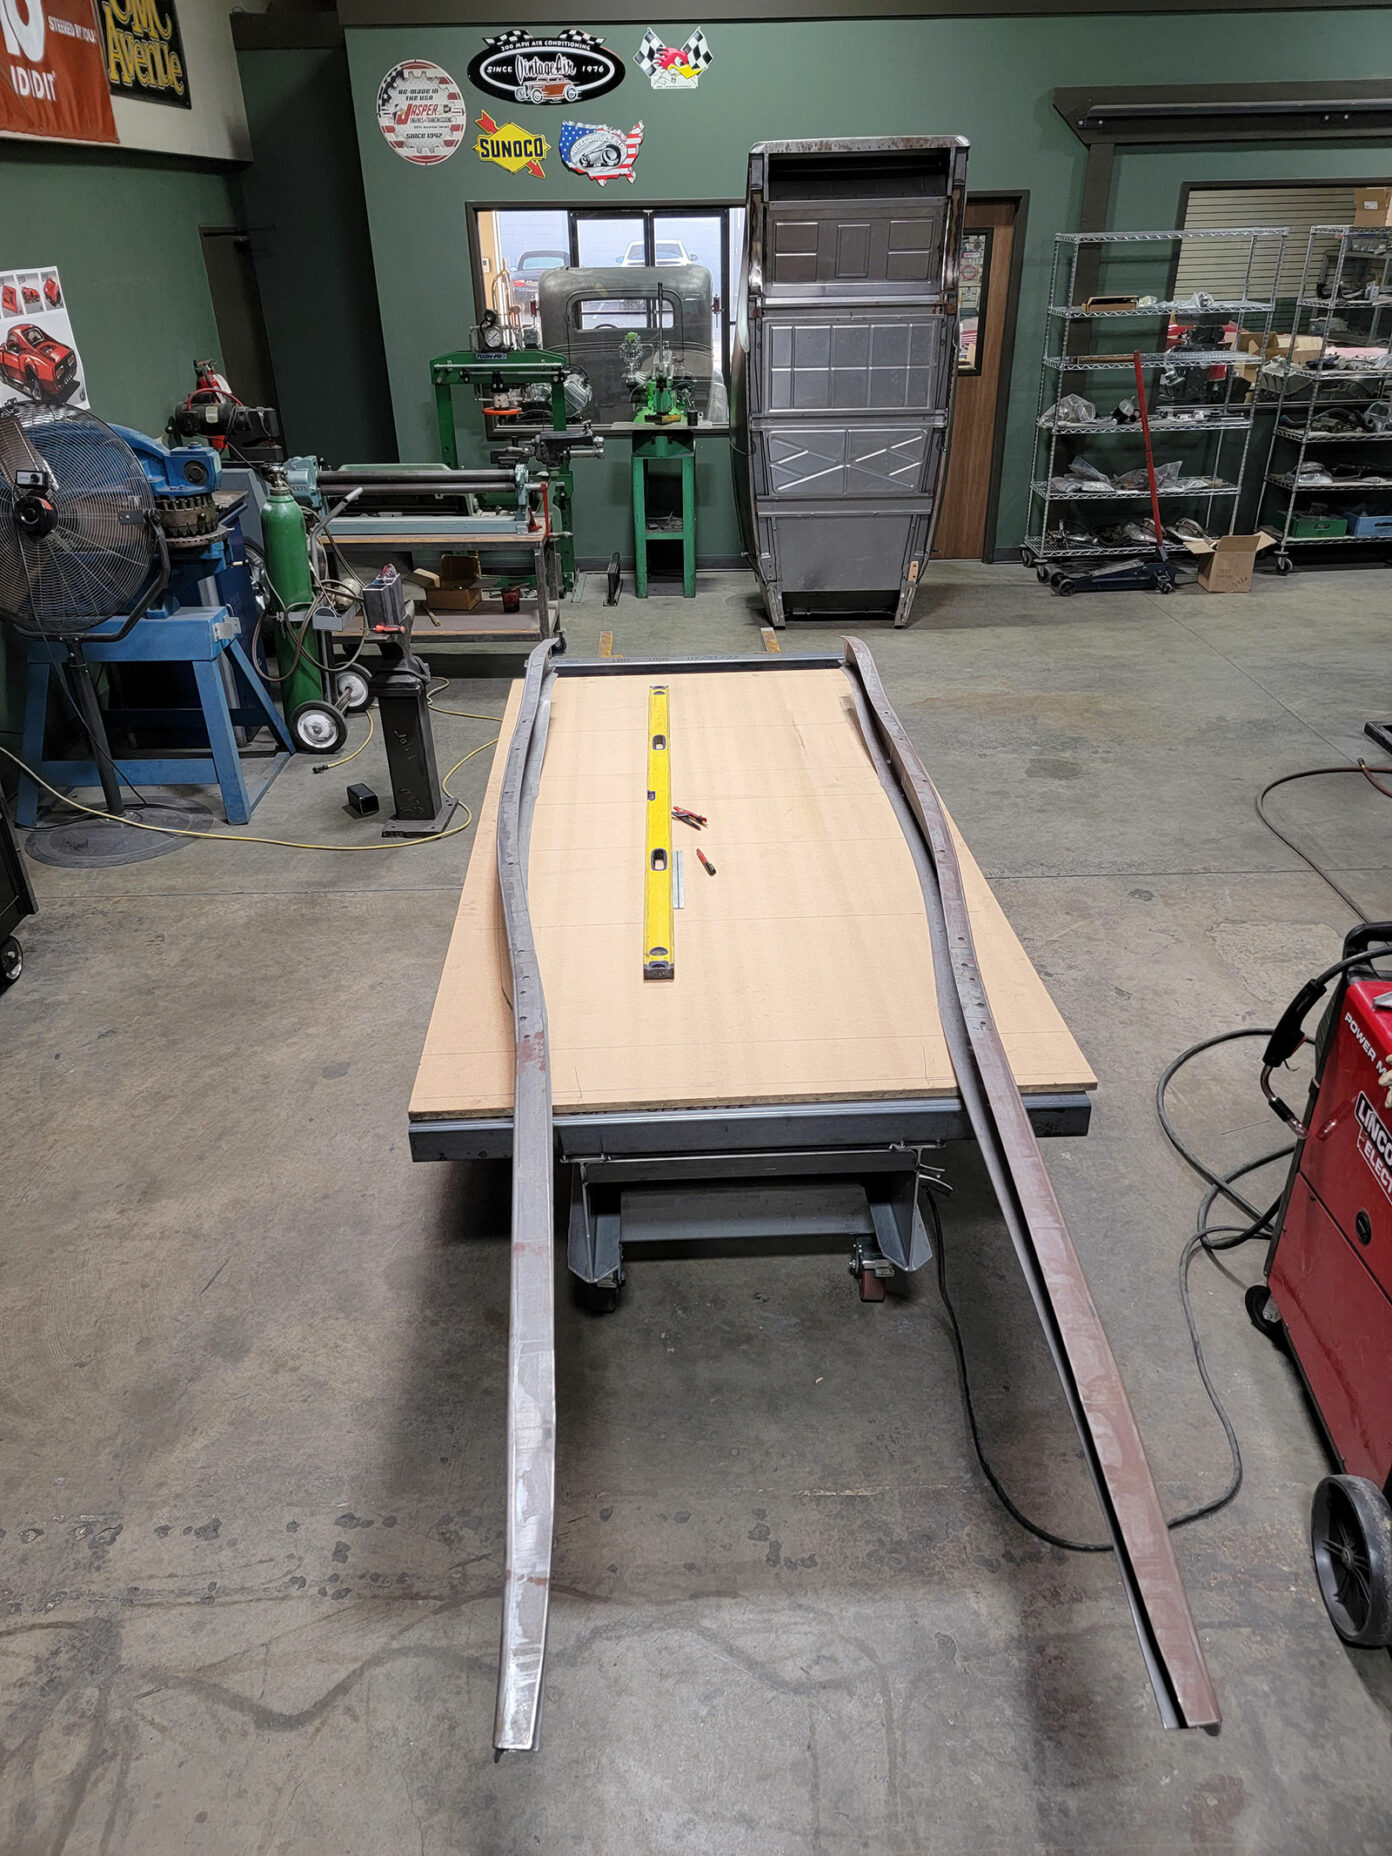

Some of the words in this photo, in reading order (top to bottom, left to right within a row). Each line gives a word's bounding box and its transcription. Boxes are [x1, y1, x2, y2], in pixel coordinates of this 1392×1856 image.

[102, 1, 185, 96] Avenue
[544, 40, 591, 51] CONDITIONING
[10, 65, 56, 101] IDIDIT
[515, 54, 555, 84] Vintage
[582, 65, 604, 73] 1976
[395, 103, 439, 125] JASPER
[480, 137, 544, 158] SUNOCO
[1344, 1012, 1377, 1062] POWER
